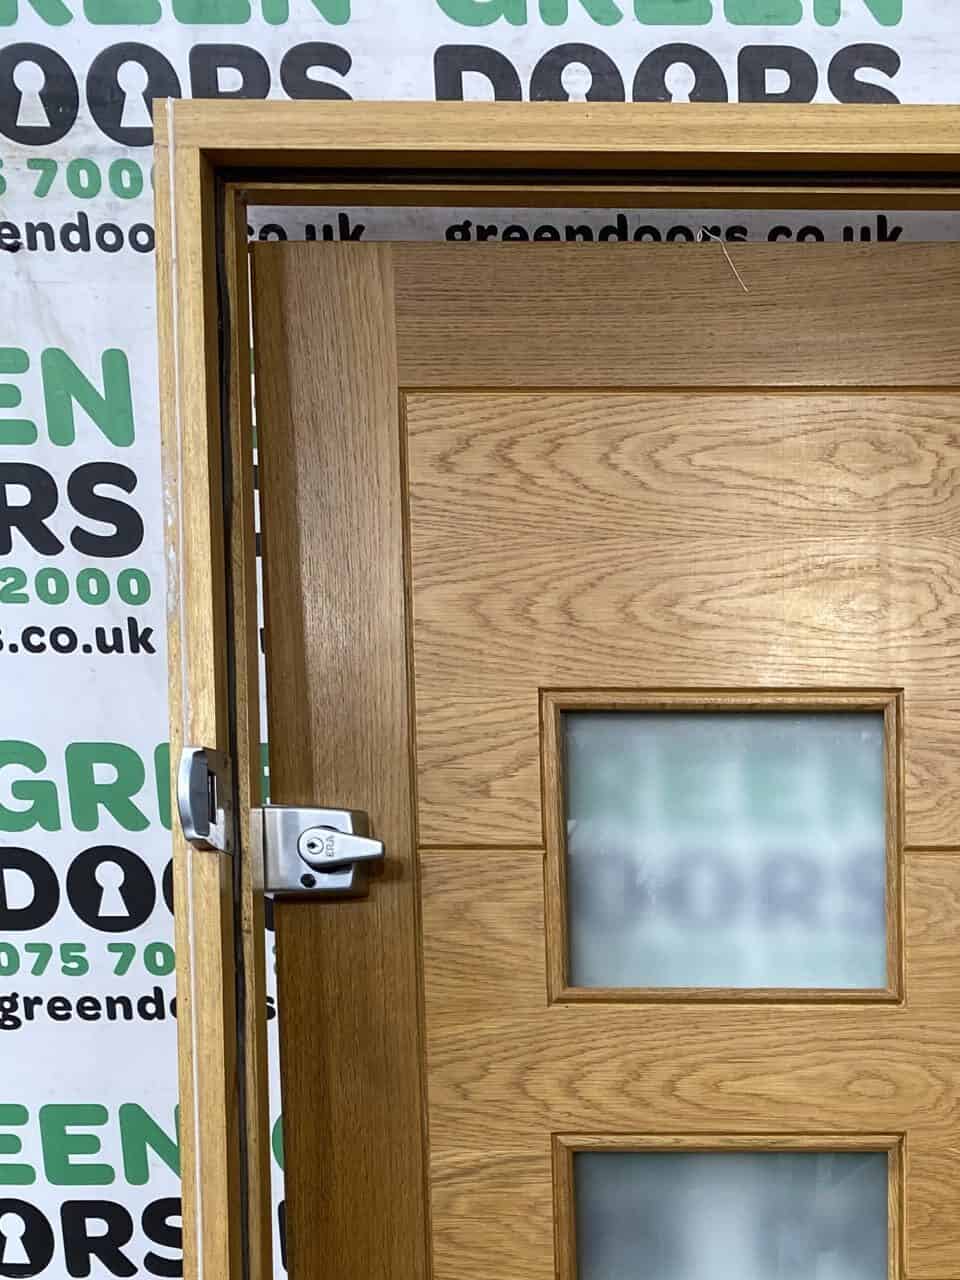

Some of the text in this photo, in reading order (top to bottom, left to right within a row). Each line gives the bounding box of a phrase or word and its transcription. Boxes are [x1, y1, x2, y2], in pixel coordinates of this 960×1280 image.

[27, 158, 154, 200] 700
[445, 214, 903, 242] greendoorscouk
[0, 567, 151, 606] 2000
[0, 617, 156, 654] .co.uk
[0, 740, 172, 832] GR
[0, 845, 174, 933] DO
[0, 986, 177, 1030] greend
